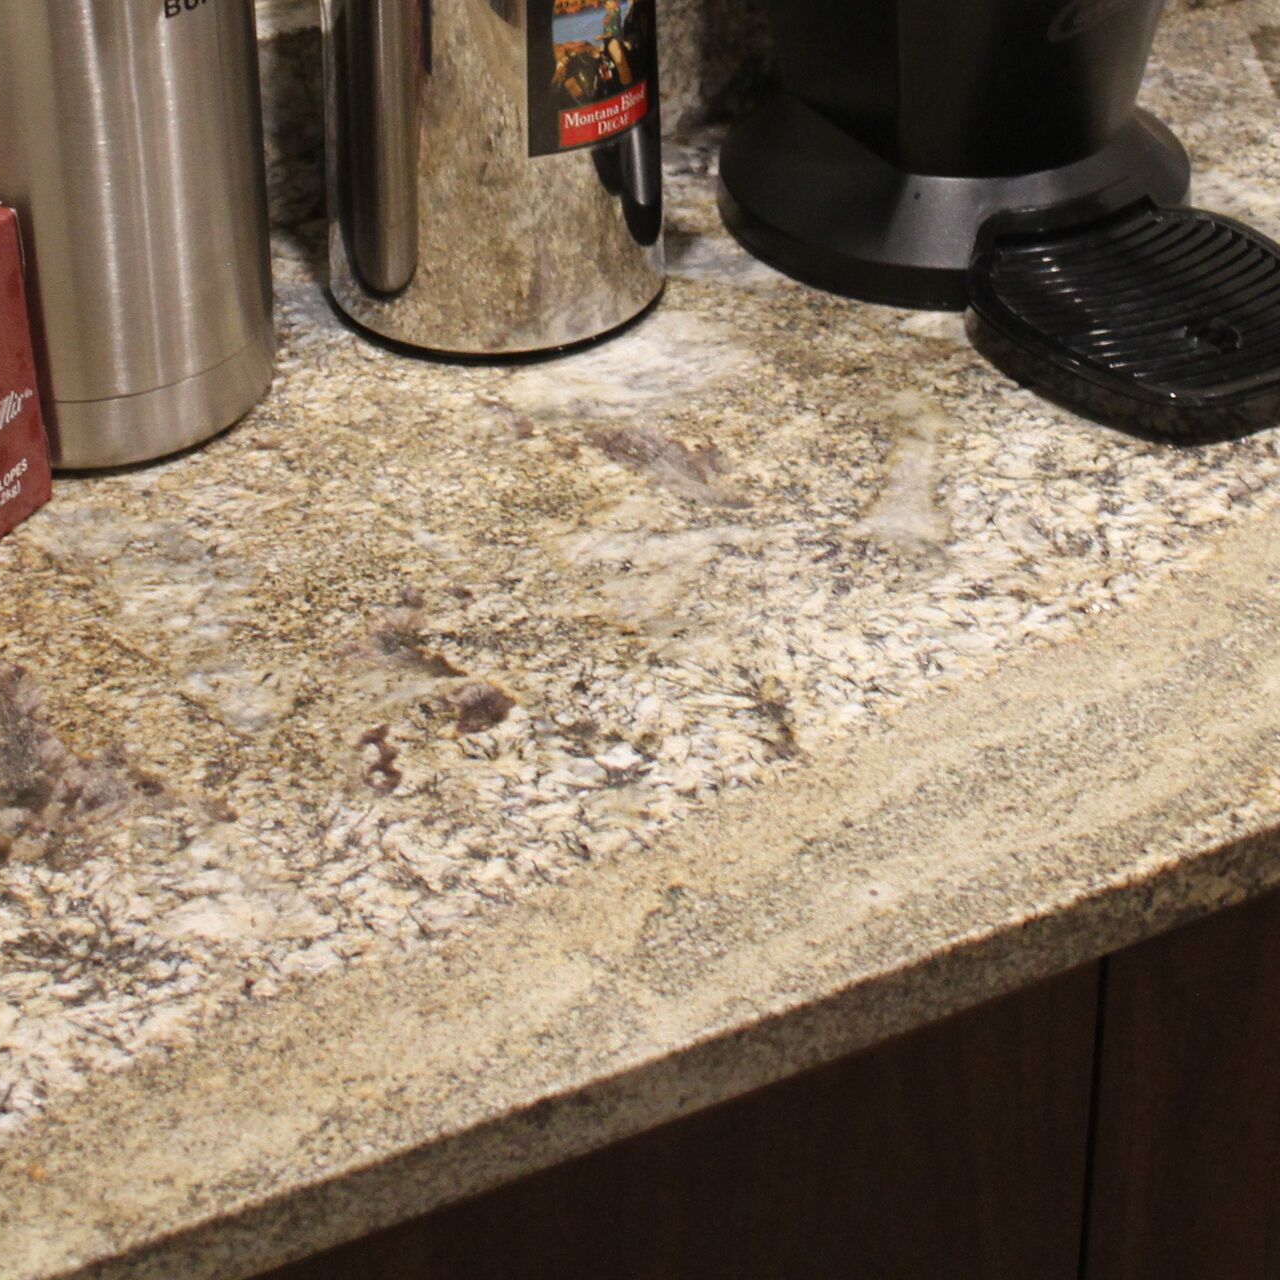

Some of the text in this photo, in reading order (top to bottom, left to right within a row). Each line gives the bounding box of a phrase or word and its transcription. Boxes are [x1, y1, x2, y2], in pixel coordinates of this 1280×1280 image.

[564, 82, 646, 129] Montana Blend
[597, 112, 629, 135] DECAF
